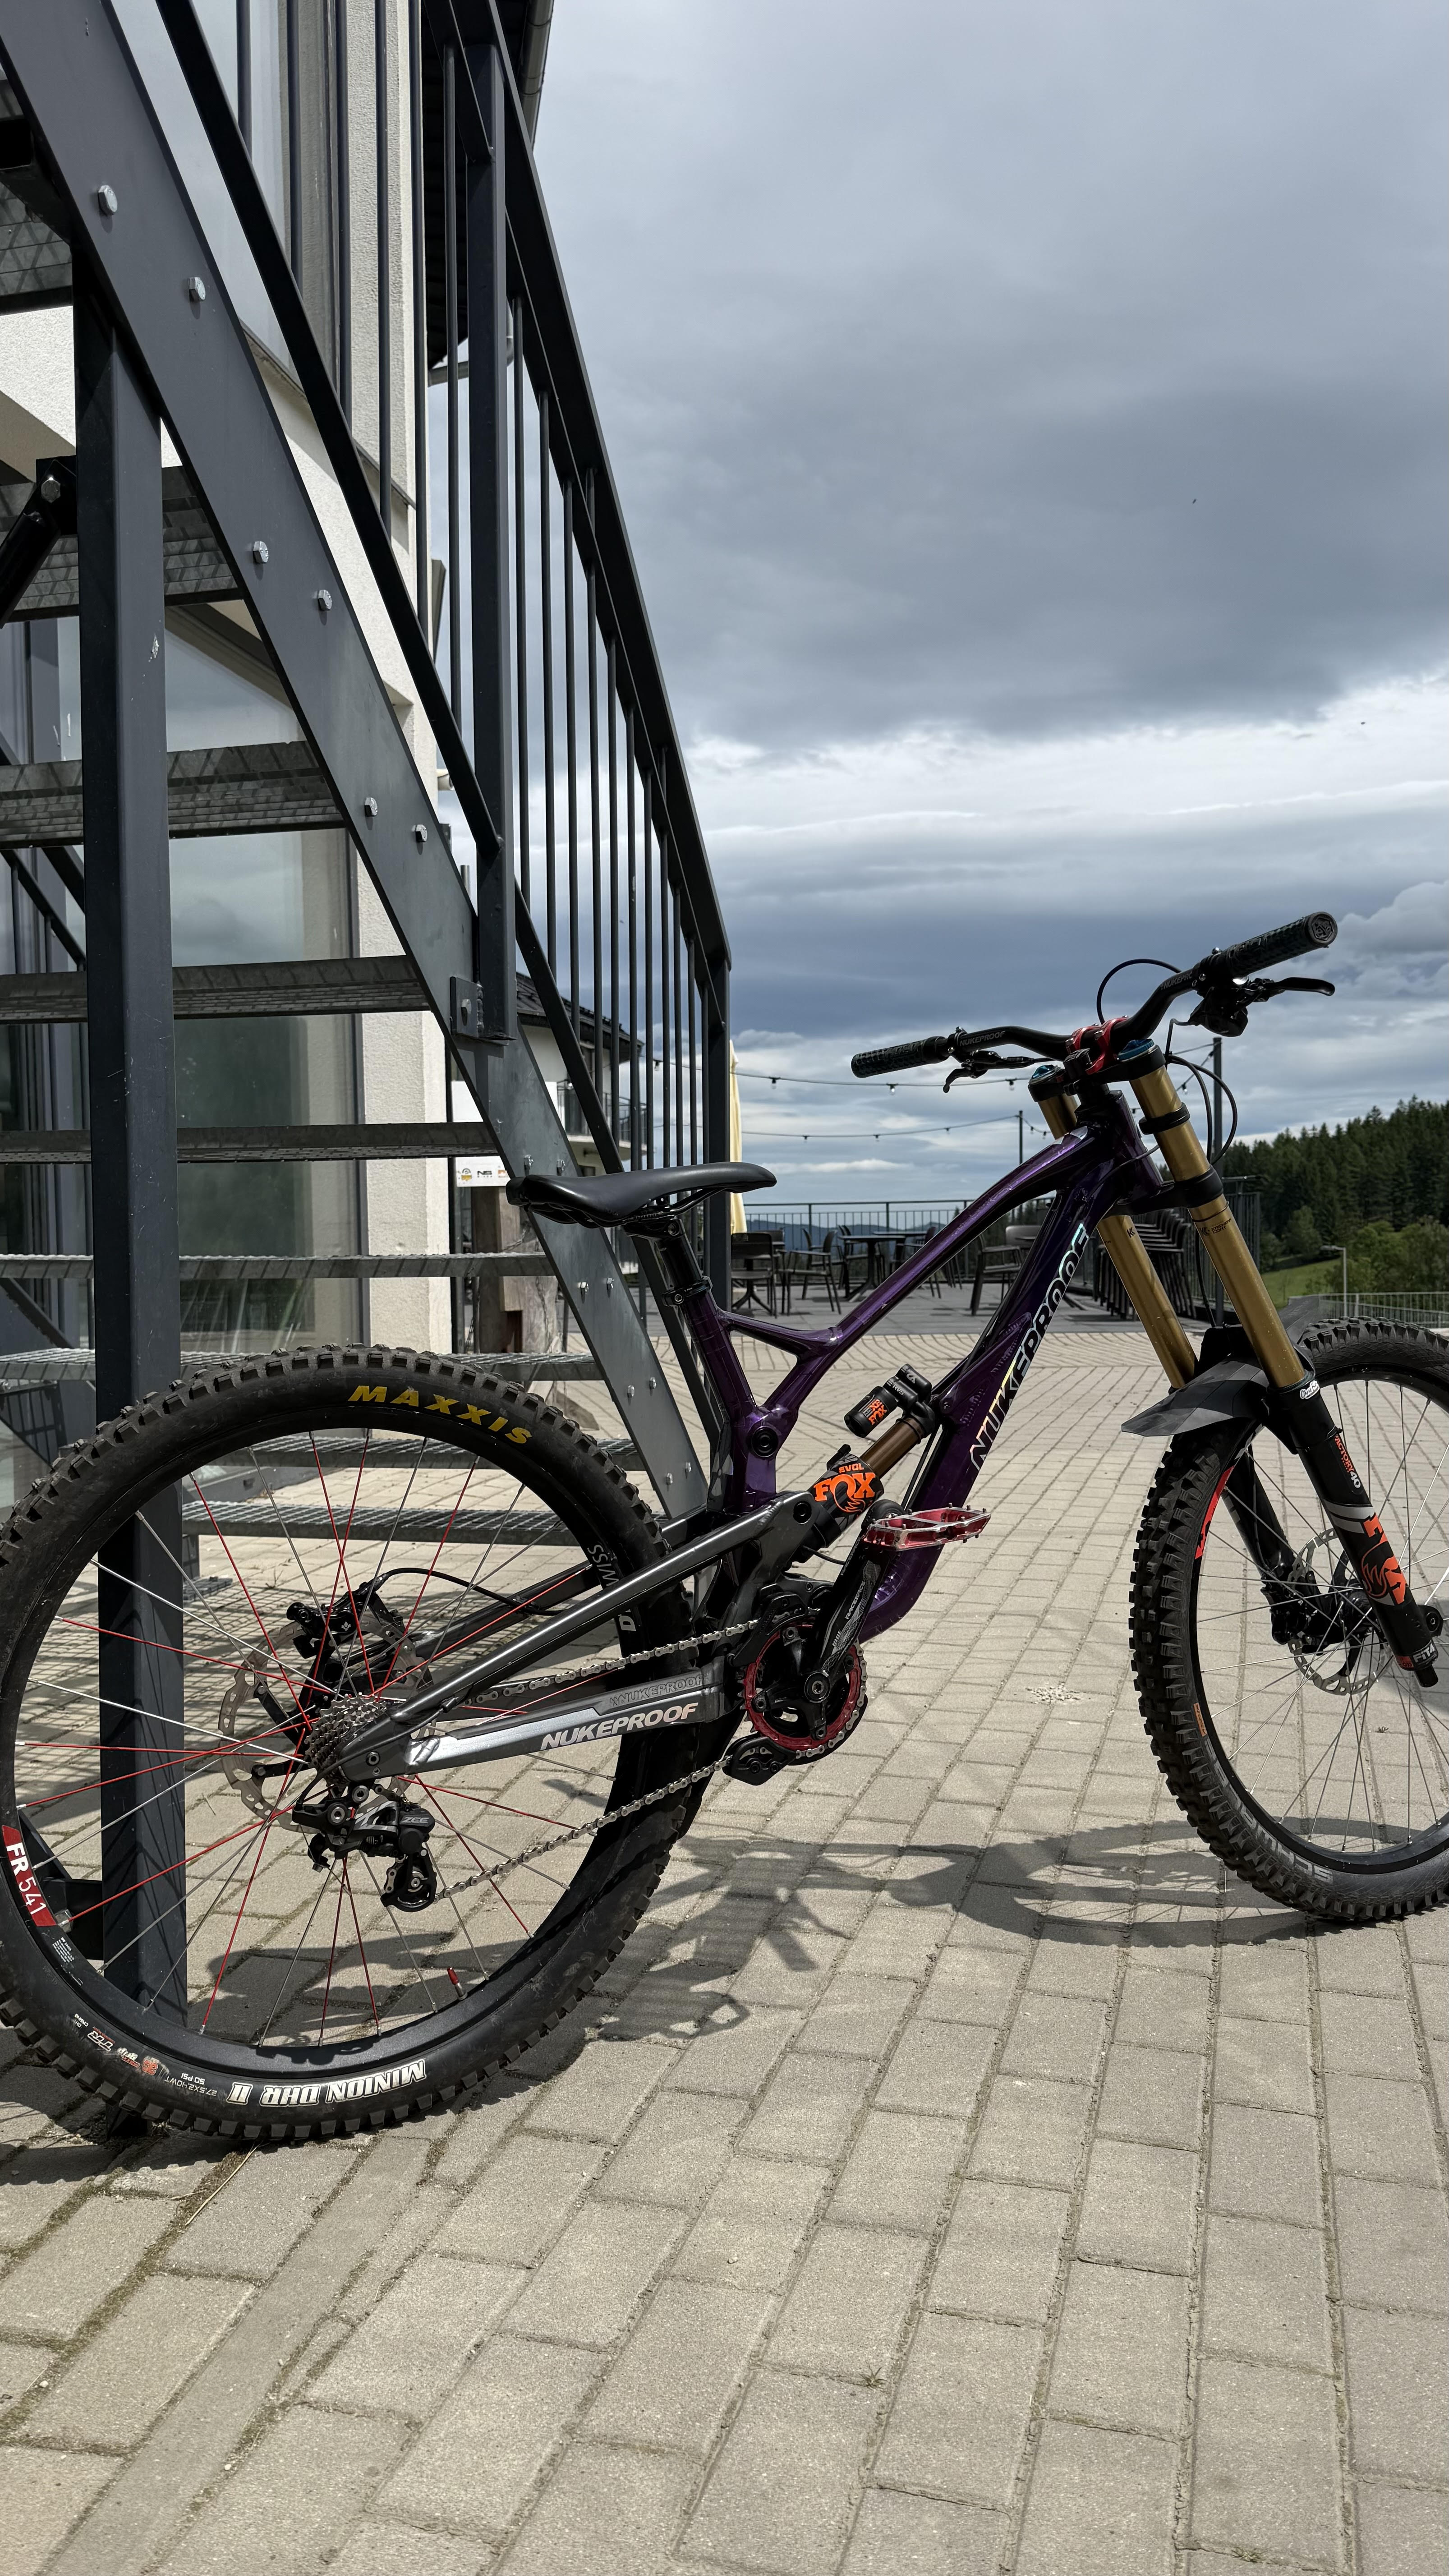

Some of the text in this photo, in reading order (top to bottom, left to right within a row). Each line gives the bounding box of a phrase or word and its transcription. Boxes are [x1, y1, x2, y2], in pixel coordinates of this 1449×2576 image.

[960, 1030, 1006, 1046] NUKEPROOF
[348, 1385, 532, 1444] MAXXIS
[839, 1463, 865, 1473] EVOL
[1350, 1471, 1361, 1488] 40
[814, 1472, 876, 1513] FOX
[587, 1544, 620, 1587] WISS
[541, 1702, 699, 1751] NUKEPROOF
[6, 1842, 47, 1915] FR 541
[87, 2030, 113, 2052] TR
[181, 2072, 206, 2085] 50 PSI
[326, 2059, 426, 2104] MINION
[260, 2083, 321, 2107] DHR
